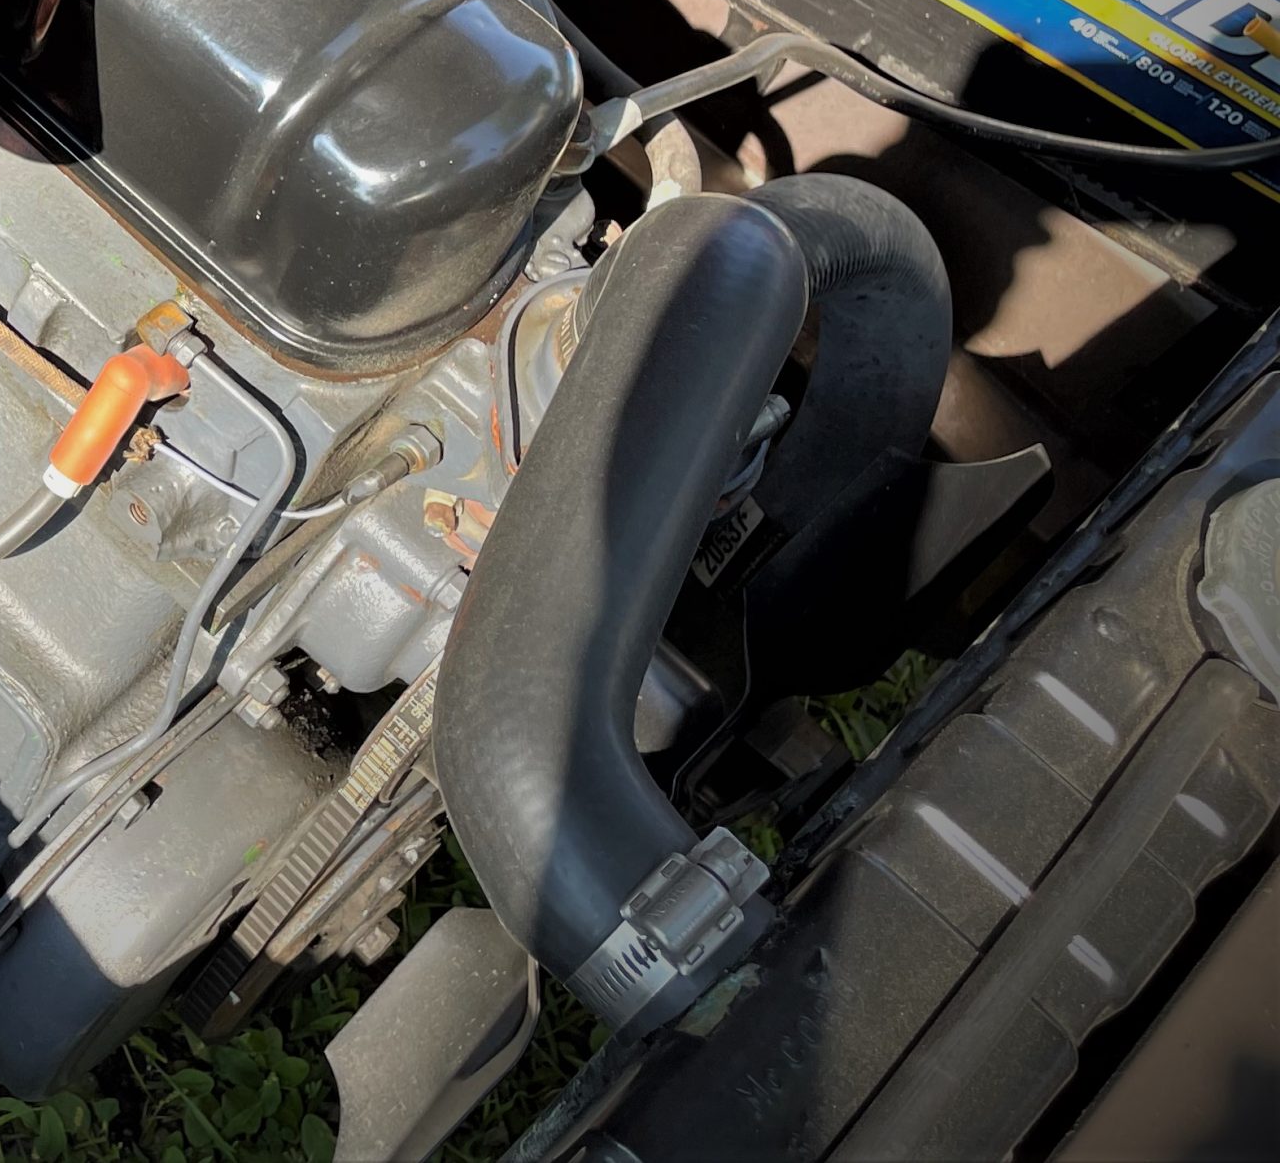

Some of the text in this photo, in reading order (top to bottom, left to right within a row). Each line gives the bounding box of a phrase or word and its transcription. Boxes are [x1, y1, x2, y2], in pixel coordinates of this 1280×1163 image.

[1069, 17, 1098, 38] 40
[1135, 55, 1176, 85] 800
[1148, 30, 1216, 77] GLOBAL
[1213, 68, 1280, 120] EXTREM
[1207, 97, 1245, 126] 120
